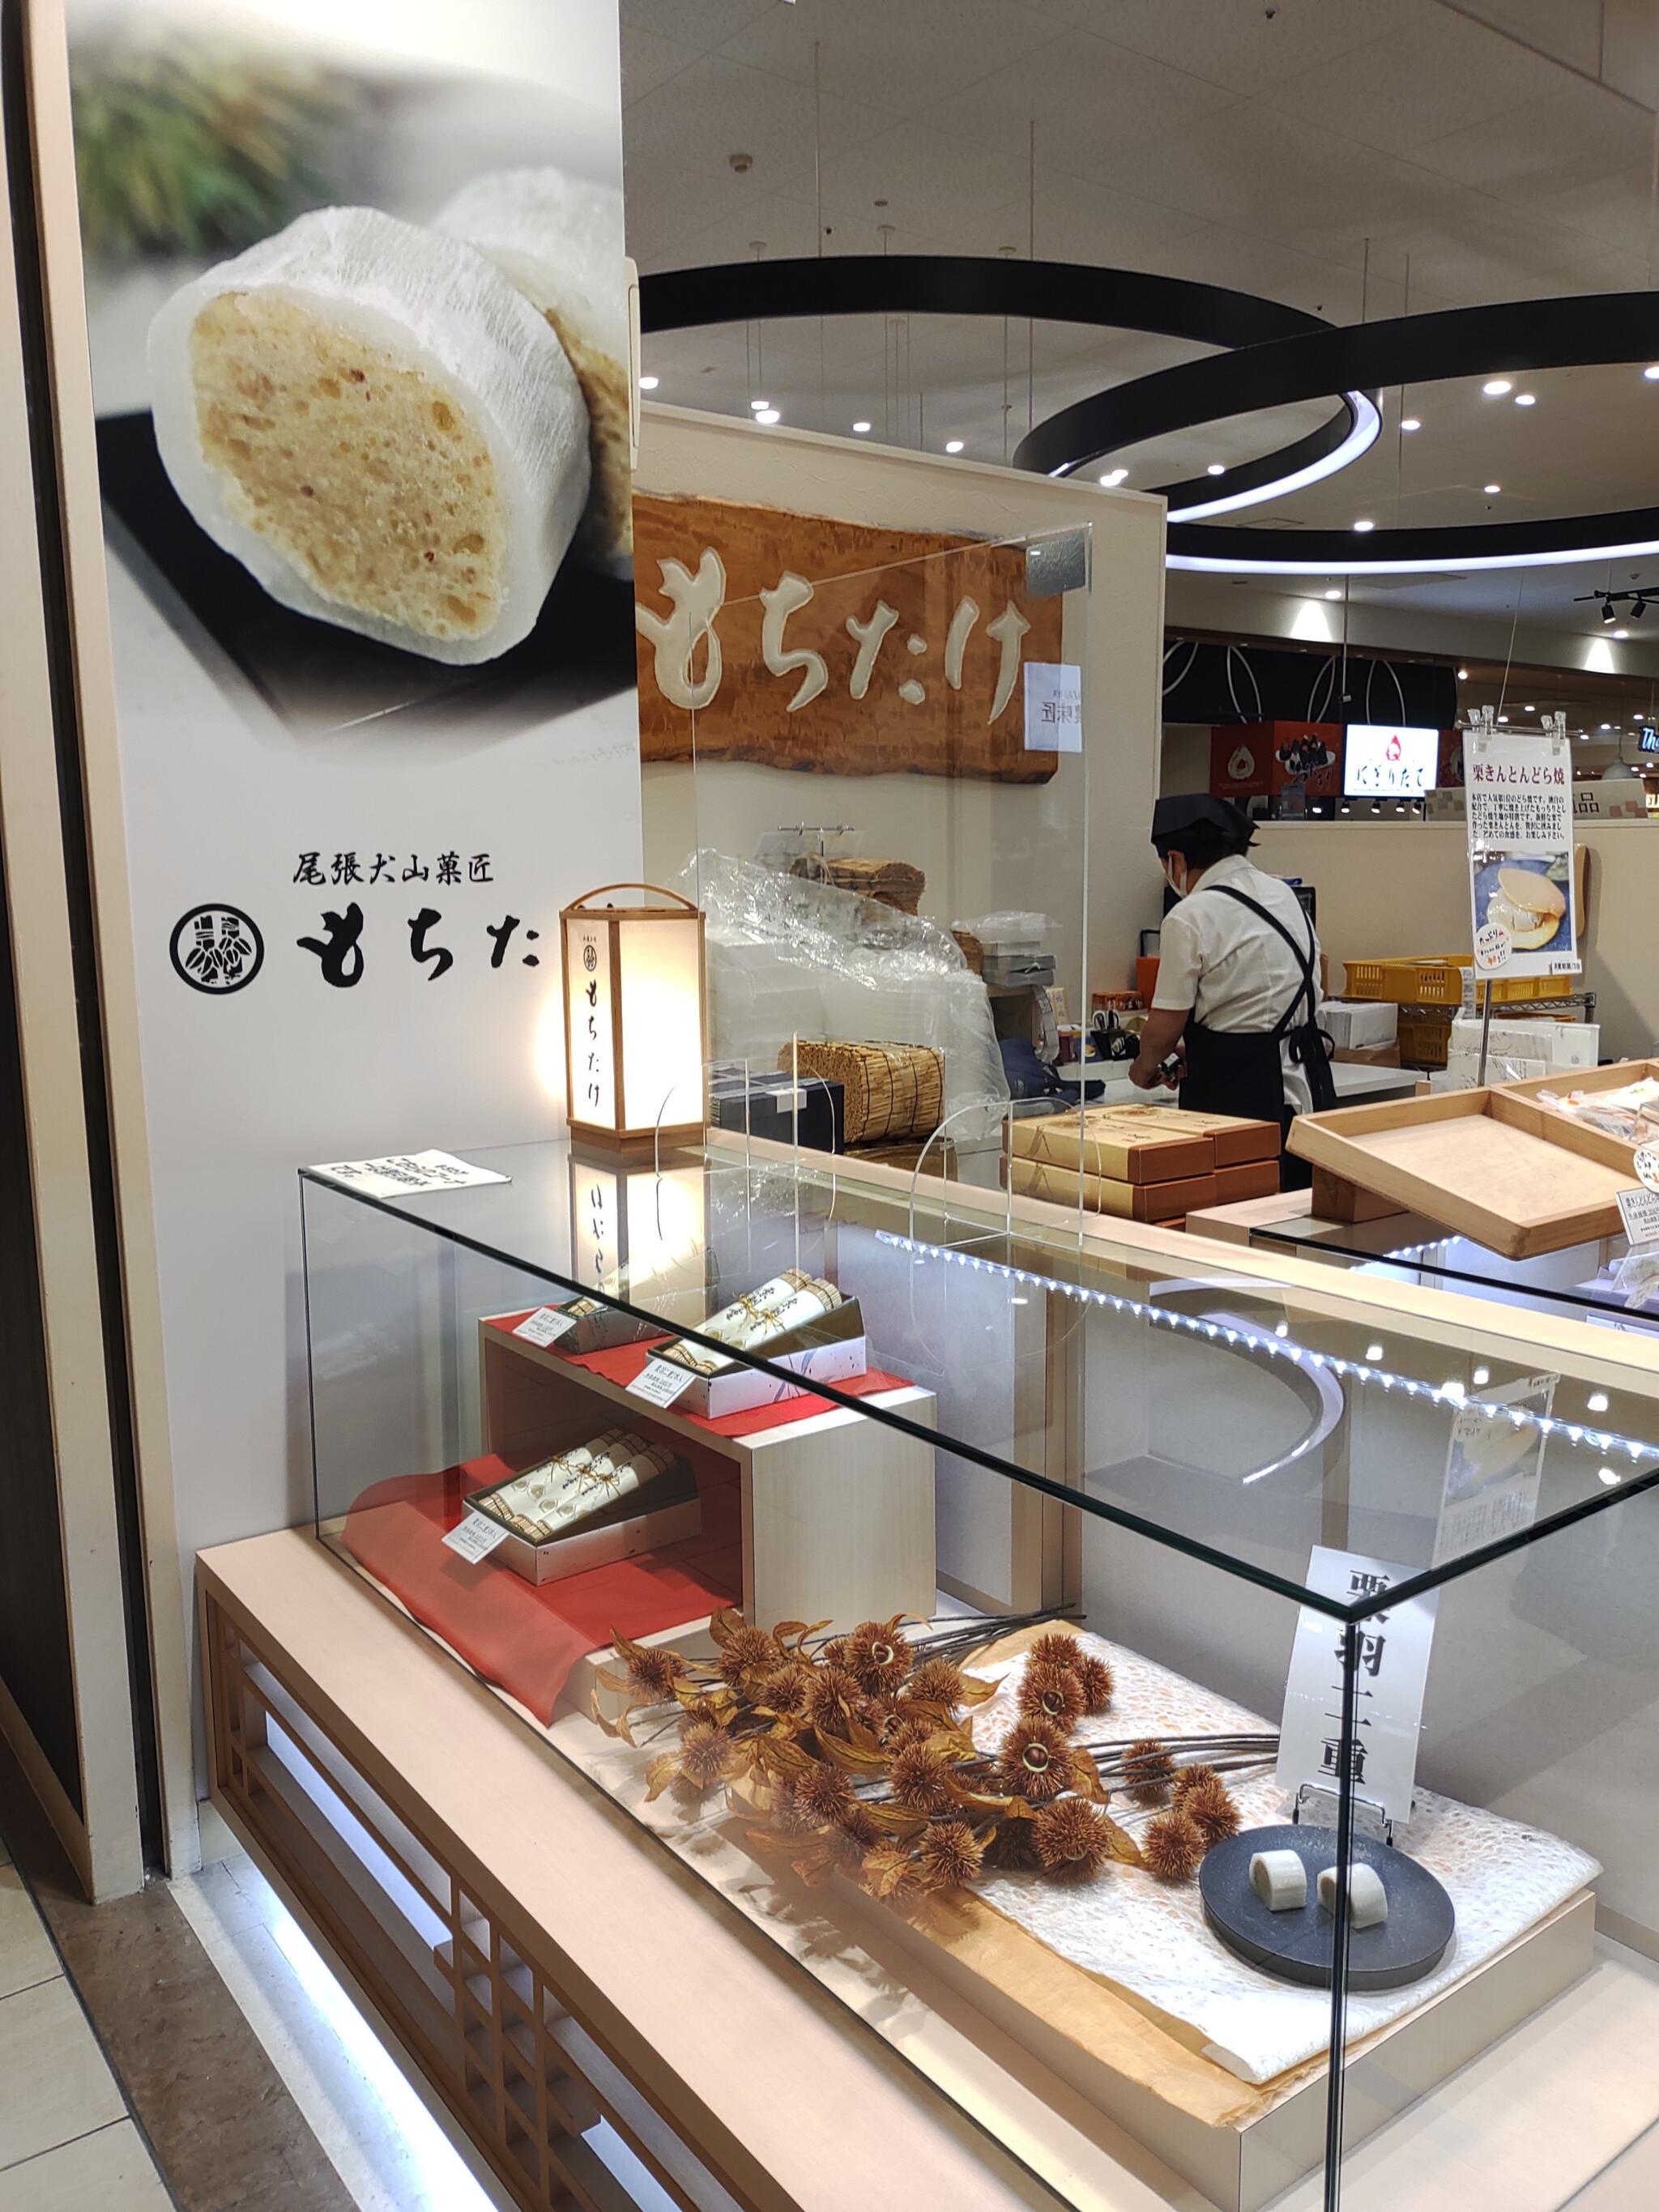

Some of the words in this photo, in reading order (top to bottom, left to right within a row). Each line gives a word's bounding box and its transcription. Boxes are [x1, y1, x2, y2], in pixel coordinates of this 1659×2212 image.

[635, 546, 1031, 726] もちたけ
[1473, 763, 1565, 785] 栗きんとんどら焼
[292, 851, 494, 885] 尾張犬山菓匠
[586, 978, 600, 1108] もちたけ
